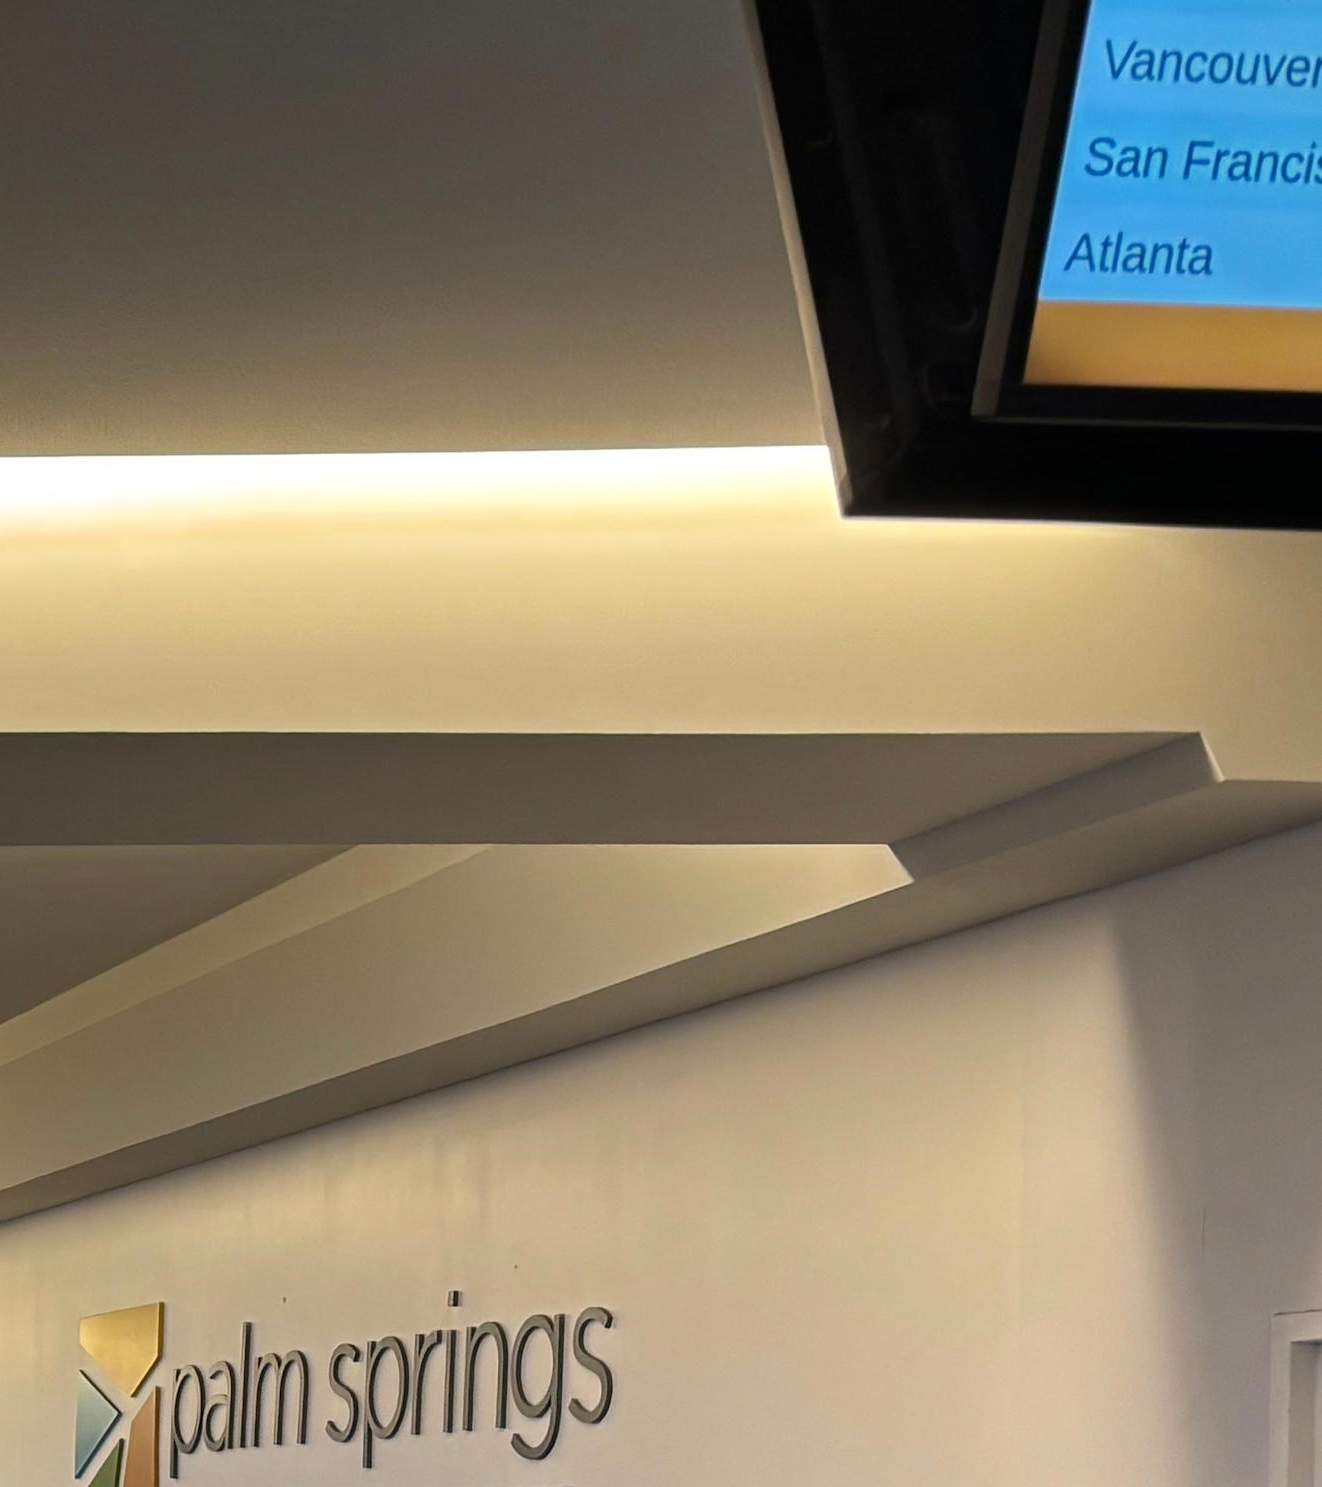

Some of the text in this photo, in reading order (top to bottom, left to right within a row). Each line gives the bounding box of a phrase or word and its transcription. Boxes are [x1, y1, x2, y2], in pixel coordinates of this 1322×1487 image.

[1084, 136, 1169, 180] San
[1063, 231, 1214, 276] Atlanta
[169, 1290, 614, 1480] palm springs
